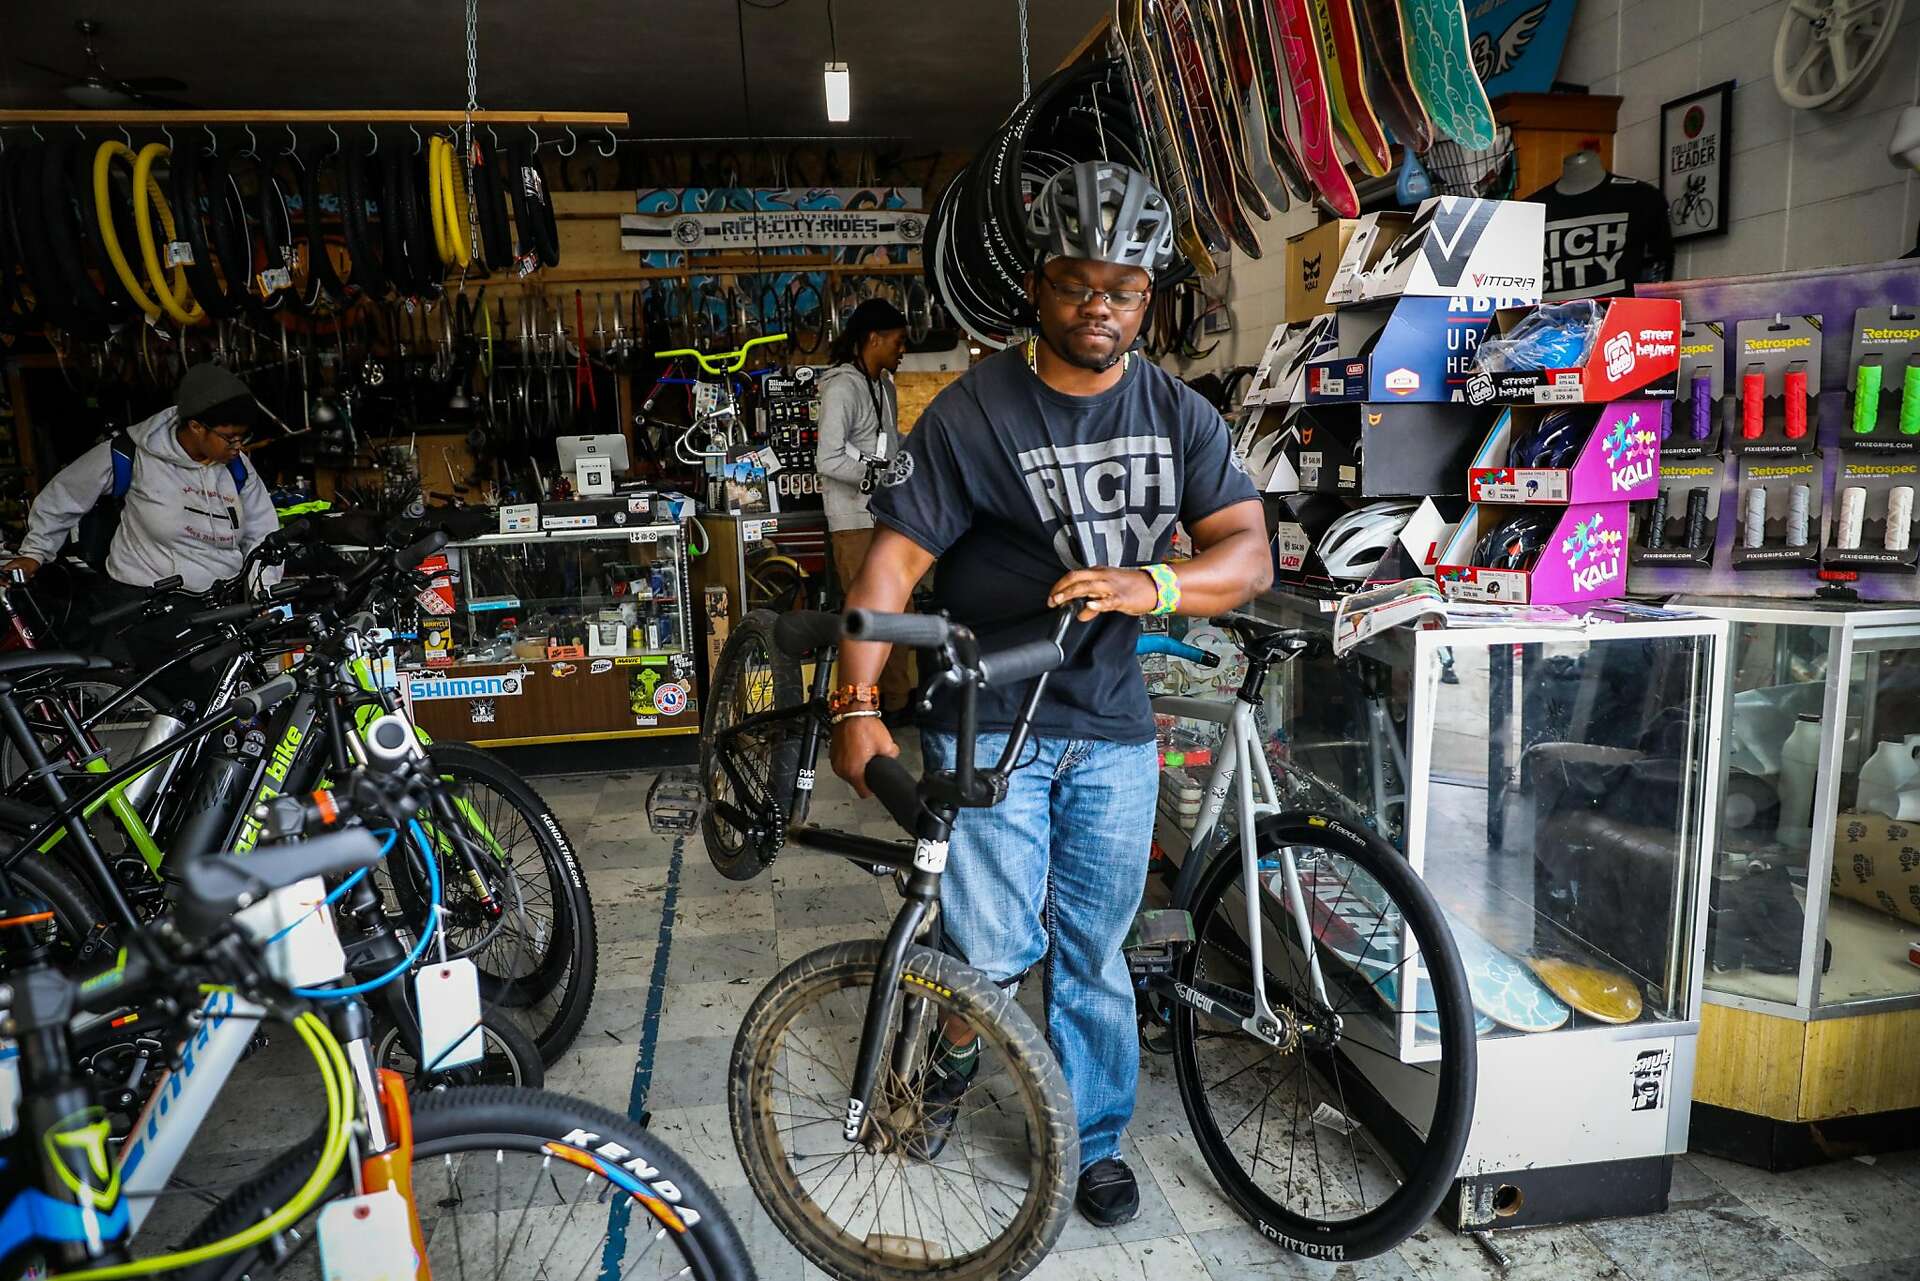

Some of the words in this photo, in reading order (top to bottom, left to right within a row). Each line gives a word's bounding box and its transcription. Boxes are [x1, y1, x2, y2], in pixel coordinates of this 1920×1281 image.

[1671, 139, 1698, 156] FOLLOW
[1701, 134, 1717, 146] THE
[1671, 145, 1716, 173] LEADER
[1544, 250, 1625, 293] ITY
[1681, 343, 1714, 355] ospec
[1744, 336, 1812, 350] Retrospec
[768, 379, 795, 388] Blinder
[1854, 441, 1914, 449] FIXIEGRIPS.COM
[1611, 457, 1654, 492] KALI
[1748, 464, 1814, 477] Retrospec
[1845, 463, 1919, 475] Retrospec
[1022, 455, 1176, 524] RICH
[1052, 513, 1178, 572] CITY
[1746, 551, 1801, 559] FIXIEGRIPS.COM
[1281, 555, 1301, 568] LAZER
[1839, 553, 1899, 561] FIXIEGRIPS.COM
[1572, 557, 1619, 593] KALI
[410, 677, 519, 700] SHIMAN
[265, 725, 303, 784] bike
[1328, 819, 1367, 848] Freedom
[540, 813, 582, 888] KENDATIRE.COM
[899, 971, 952, 999] AXXIS
[560, 1127, 702, 1227] KENDA
[1257, 1218, 1345, 1261] thickslick
